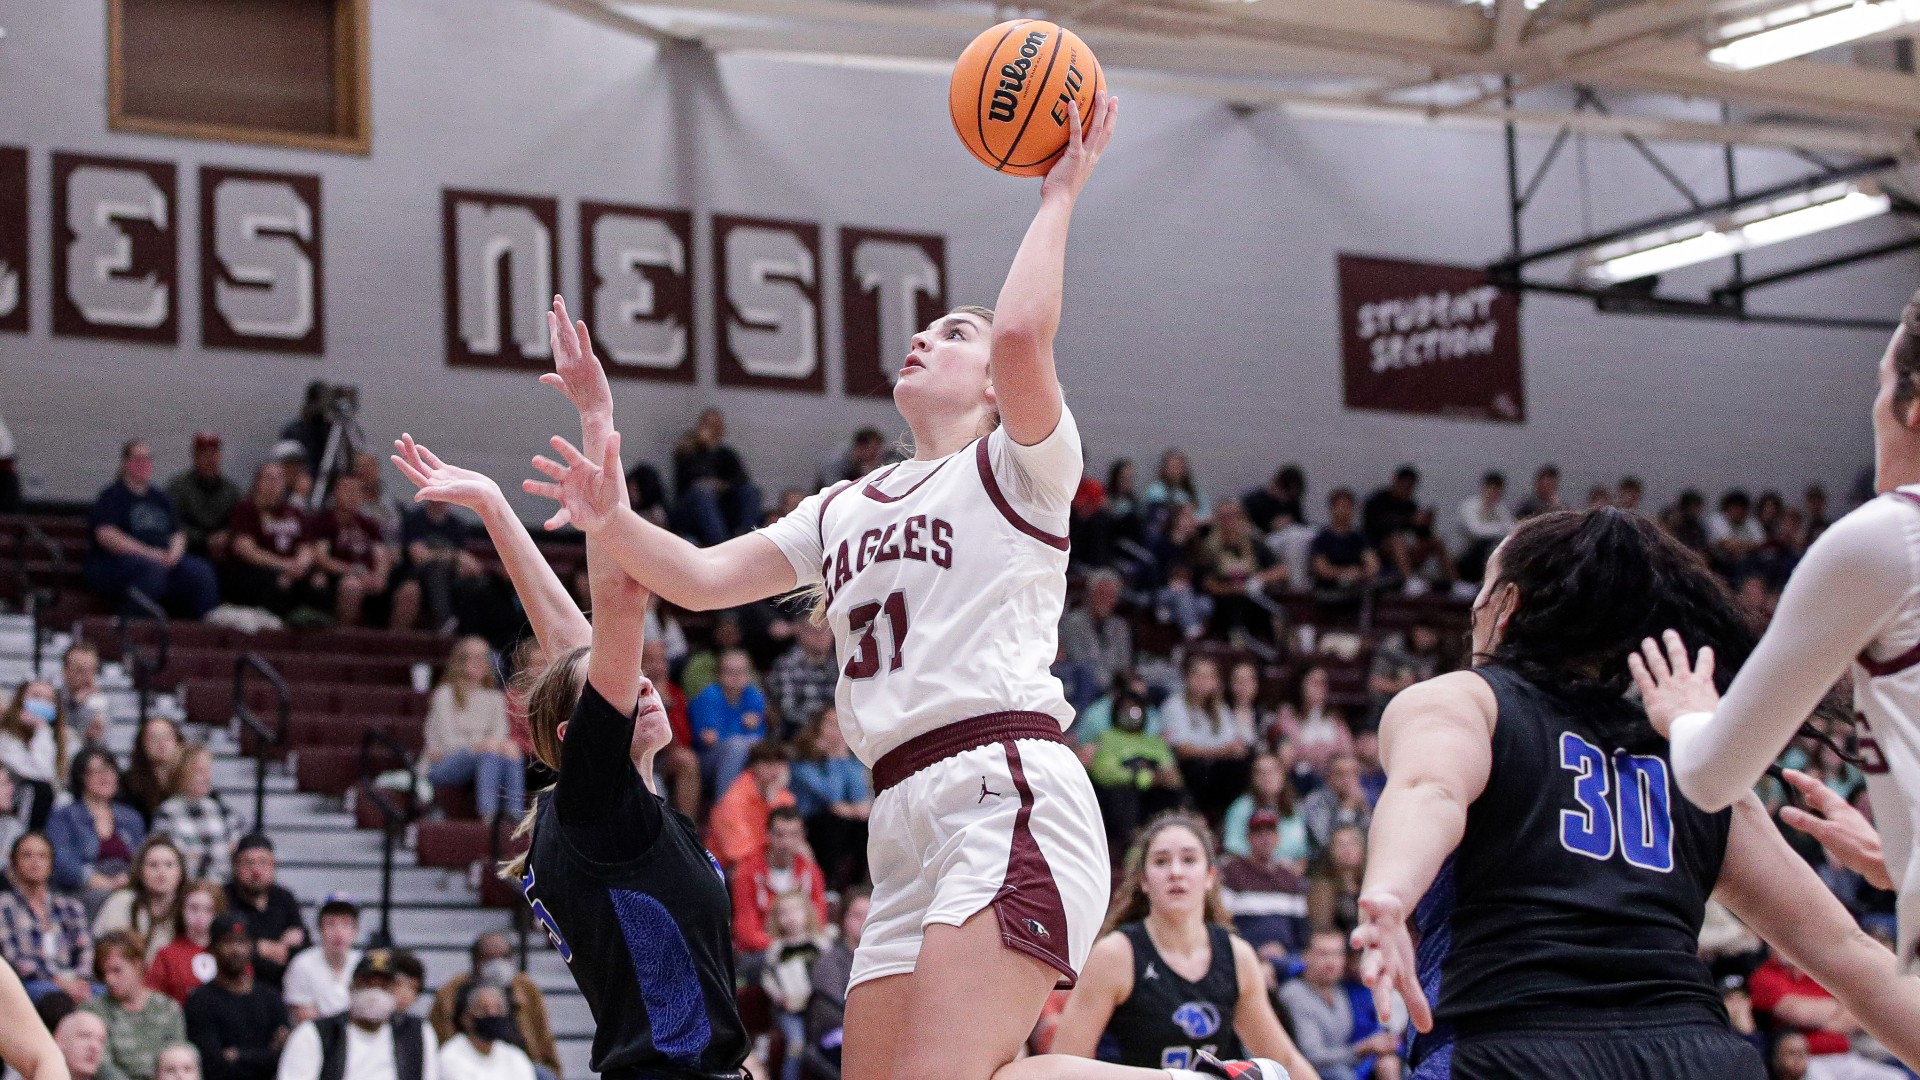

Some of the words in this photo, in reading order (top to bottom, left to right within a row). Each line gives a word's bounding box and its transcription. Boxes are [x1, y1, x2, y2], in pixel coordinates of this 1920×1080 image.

[988, 31, 1049, 123] Wilson
[0, 163, 314, 340] ES
[455, 200, 941, 385] NEST
[1357, 285, 1499, 340] STUDENT
[1370, 320, 1498, 374] SECTION
[821, 514, 954, 614] EAGLES
[844, 588, 910, 682] 31
[1558, 730, 1674, 873] 30
